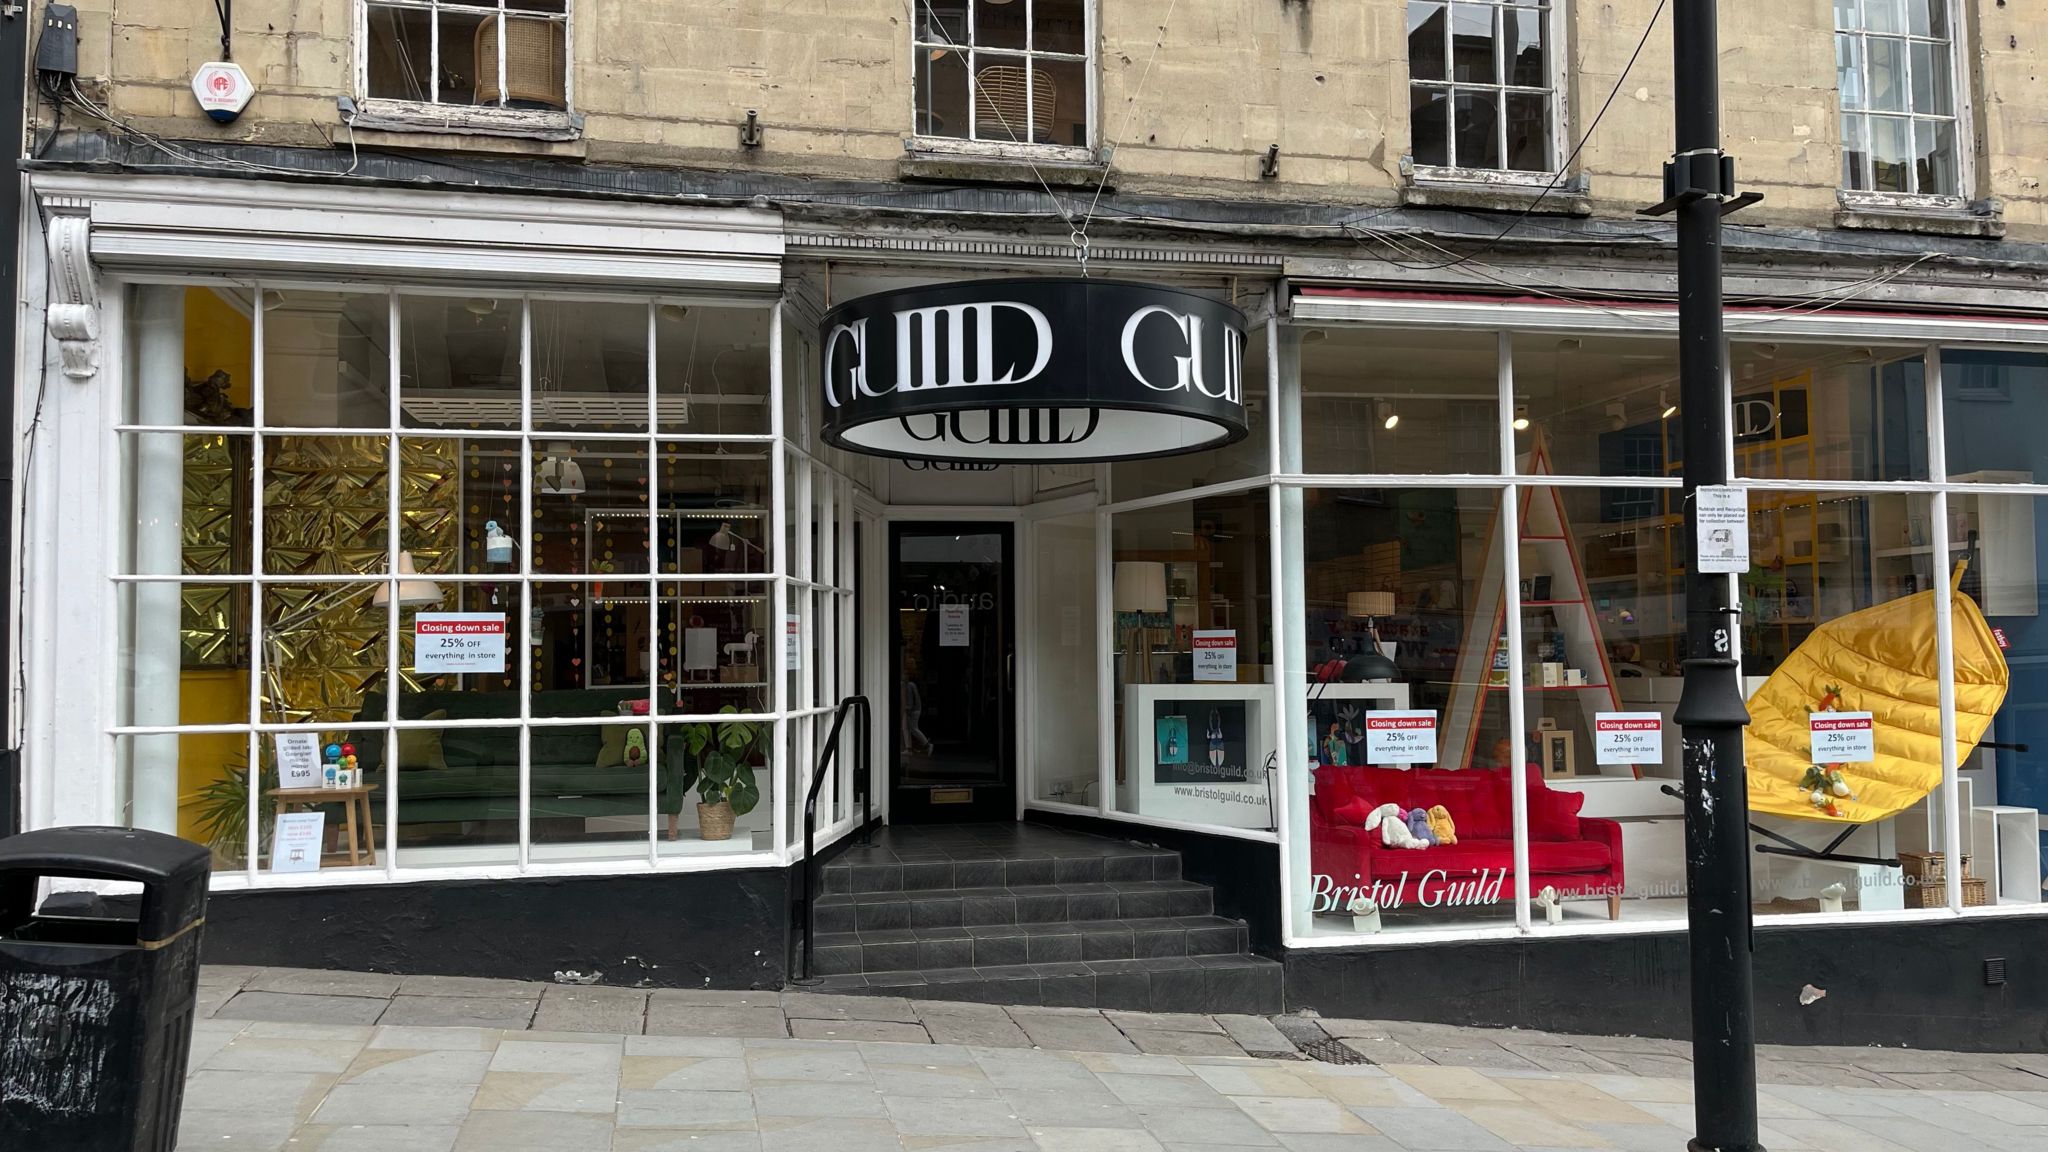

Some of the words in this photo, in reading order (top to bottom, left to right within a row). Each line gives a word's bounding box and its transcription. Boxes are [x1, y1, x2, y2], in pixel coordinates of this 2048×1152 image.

[824, 300, 1053, 408] GUILD
[421, 624, 453, 633] Closing
[455, 624, 480, 632] down
[482, 624, 500, 632] sale
[440, 638, 464, 648] 25%
[425, 652, 465, 660] everything
[1371, 720, 1396, 728] Closing
[1600, 722, 1623, 730] Closing
[1386, 733, 1405, 741] 25%
[1828, 734, 1844, 742] 25%
[1174, 786, 1267, 806] www.bristolguild.co.uk
[1305, 870, 1408, 912] Bristol
[1418, 867, 1506, 908] Guild
